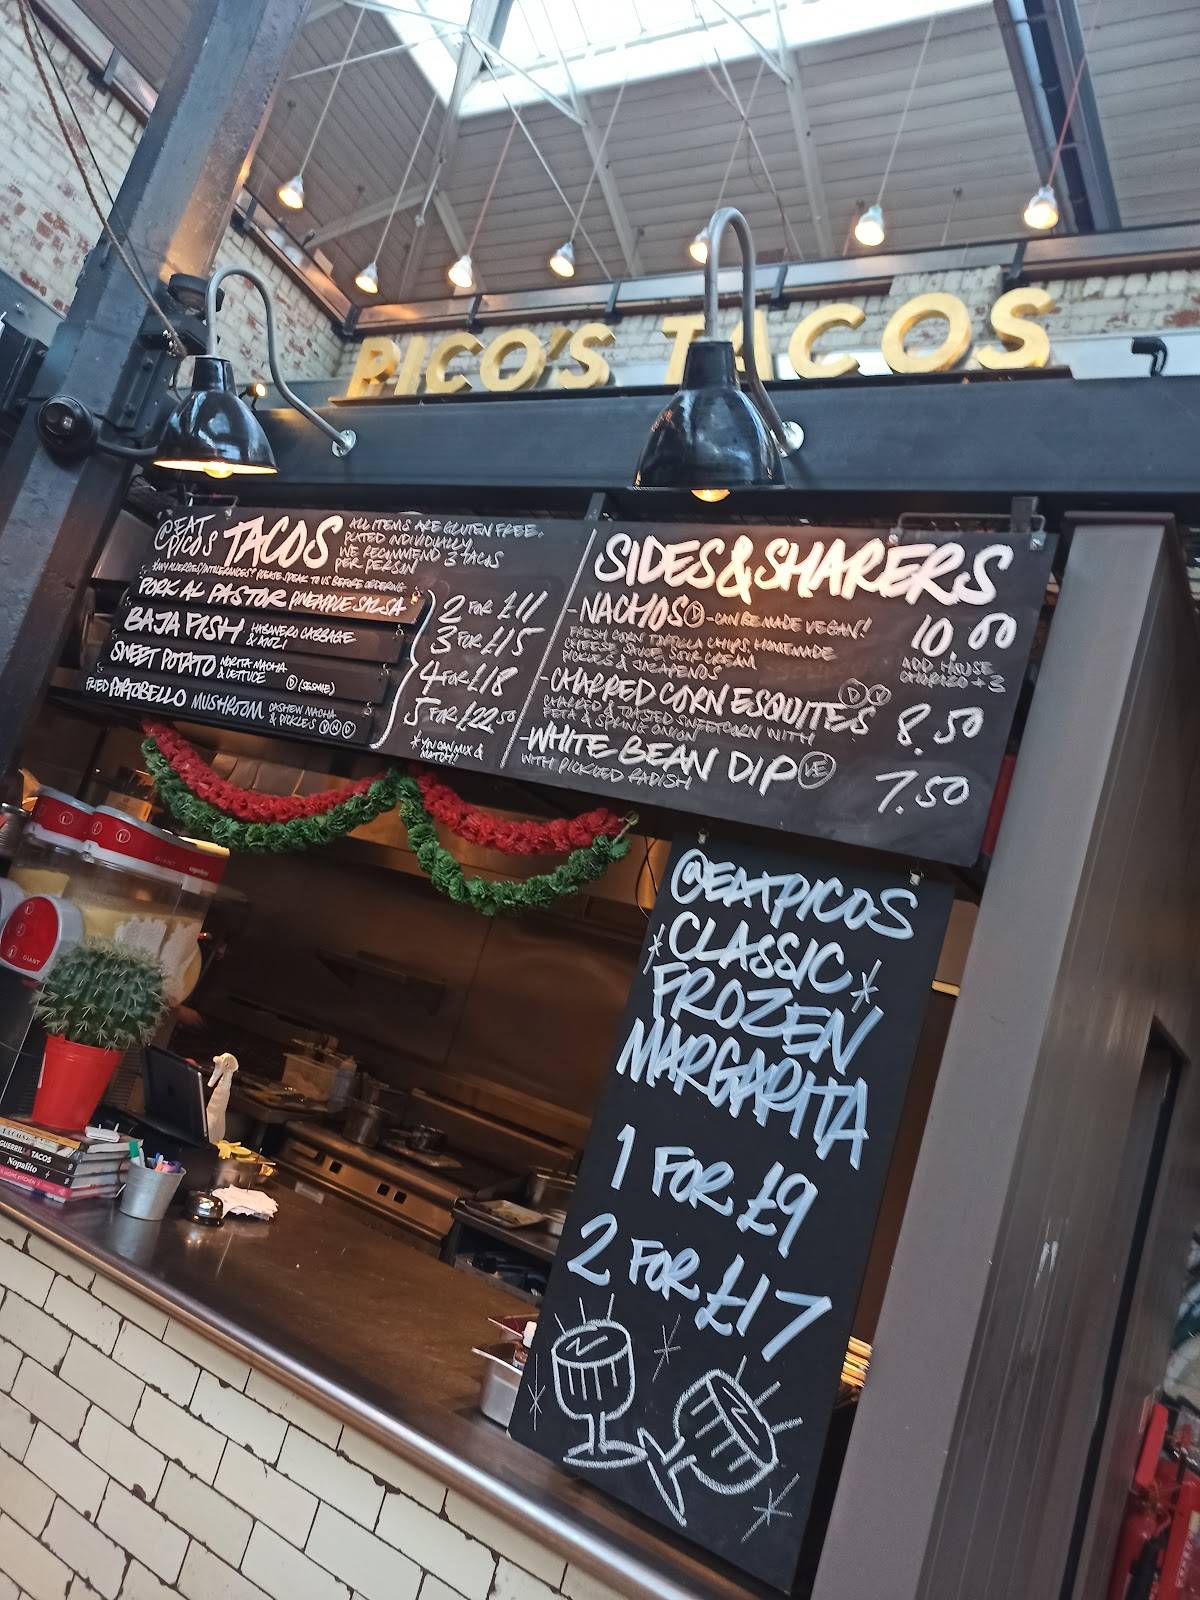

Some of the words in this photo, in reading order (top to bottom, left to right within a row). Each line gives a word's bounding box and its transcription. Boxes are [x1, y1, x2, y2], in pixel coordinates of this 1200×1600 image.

[346, 322, 616, 398] PICO'S
[154, 514, 216, 551] @EAT
[223, 515, 344, 569] TACOS
[344, 531, 386, 546] PLATED
[349, 517, 370, 531] ALL
[372, 518, 411, 532] ITEMS
[414, 519, 442, 533] ARE
[443, 521, 494, 537] GLUTEN
[167, 530, 218, 558] PICOS
[339, 545, 359, 558] WE
[363, 545, 441, 562] RECOMMEND
[444, 551, 458, 568] 3
[283, 571, 308, 584] SPEAK
[310, 575, 320, 585] TO
[320, 575, 329, 586] US
[331, 577, 364, 589] BEFORE
[335, 557, 364, 573] PER
[365, 559, 418, 575] PERSON
[138, 576, 181, 597] PORK
[179, 579, 205, 601] AL
[207, 583, 287, 608] PASTOR
[352, 596, 407, 617] SALSA
[438, 594, 466, 624] 2
[468, 600, 494, 616] FOR
[497, 591, 549, 624] £11
[124, 606, 181, 637] BAJA
[185, 612, 245, 644] FISH
[250, 622, 299, 639] HABANERO
[299, 626, 357, 644] CABBAGE
[246, 632, 258, 647] &
[430, 625, 458, 655] 3
[457, 631, 483, 649] FOR
[480, 626, 546, 657] £15
[569, 625, 609, 642] FRESH
[612, 628, 646, 643] CORN
[707, 636, 751, 655] CHIPS
[740, 611, 762, 628] BE
[762, 613, 803, 632] MADE
[805, 617, 873, 639] VEGAN!
[110, 641, 161, 669] SWEET
[161, 647, 217, 677] POTATO
[253, 659, 288, 674] MACHA
[562, 649, 615, 667] PICKLES
[564, 637, 616, 654] CHEESE
[669, 646, 703, 663] SOUR
[704, 651, 757, 671] CREAM
[902, 656, 934, 673] ADD
[940, 660, 994, 677] HOUSE
[226, 668, 267, 684] LETTUCE
[419, 660, 445, 695] 4
[442, 670, 471, 686] FOR
[467, 663, 518, 697] £18
[86, 676, 109, 693] FRIED
[108, 676, 187, 708] PORTOBELLO
[190, 692, 265, 721] MUSHROOM
[268, 702, 305, 714] CASHEW
[403, 697, 441, 726] 5
[430, 706, 458, 724] FOR
[659, 681, 730, 717] CORN
[730, 687, 877, 735] ESQUITES
[279, 715, 317, 730] PICKLES
[543, 706, 576, 721] FETA
[595, 714, 649, 734] SPRING
[651, 724, 701, 742] ONION
[767, 726, 816, 746] WITH
[436, 740, 455, 753] CAN
[454, 743, 474, 757] MIX
[521, 753, 554, 770] WITH
[558, 757, 625, 783] PICKLED
[628, 767, 693, 791] RADISH
[618, 735, 720, 782] BEAN
[728, 750, 799, 796] DIP
[670, 848, 918, 940] @EATPICOS
[668, 911, 853, 994] CLASSIC
[653, 962, 885, 1076] FROZEN
[616, 1017, 870, 1171] MARGARITA
[7, 1157, 38, 1174] Nopalito
[31, 1150, 52, 1164] TACOS
[610, 1123, 636, 1191] 1
[651, 1145, 735, 1217] FOR
[736, 1160, 819, 1259] £9
[566, 1212, 619, 1286] 2
[629, 1237, 700, 1301] FOR
[694, 1253, 833, 1363] £17
